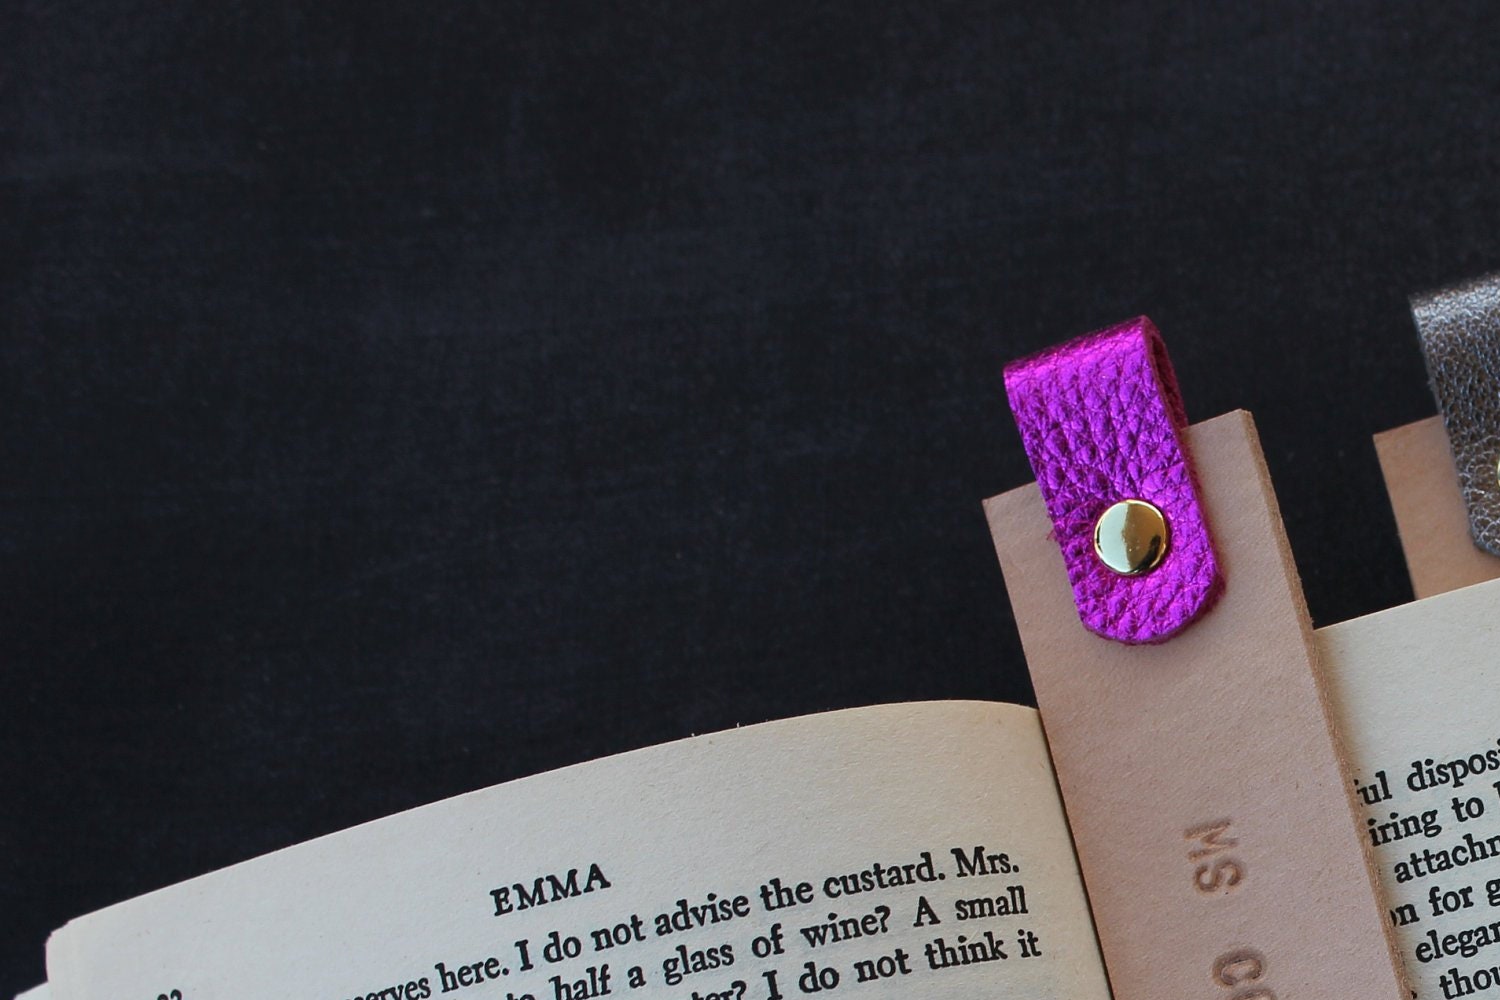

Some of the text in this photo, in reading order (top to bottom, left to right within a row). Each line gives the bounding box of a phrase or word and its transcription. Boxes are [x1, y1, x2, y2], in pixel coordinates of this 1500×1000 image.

[489, 862, 612, 917] EMMA
[1183, 817, 1244, 893] MS
[434, 957, 510, 994] here.
[513, 938, 534, 972] I
[542, 930, 582, 964] do
[589, 913, 647, 952] not
[654, 892, 751, 937] advise
[759, 877, 815, 912] the
[822, 851, 946, 899] custard.
[949, 845, 1020, 878] Mrs.
[627, 965, 647, 990] a
[662, 943, 735, 987] glass
[751, 922, 786, 959] of
[799, 904, 891, 949] wine?
[912, 895, 942, 928] A
[954, 884, 1029, 921] small
